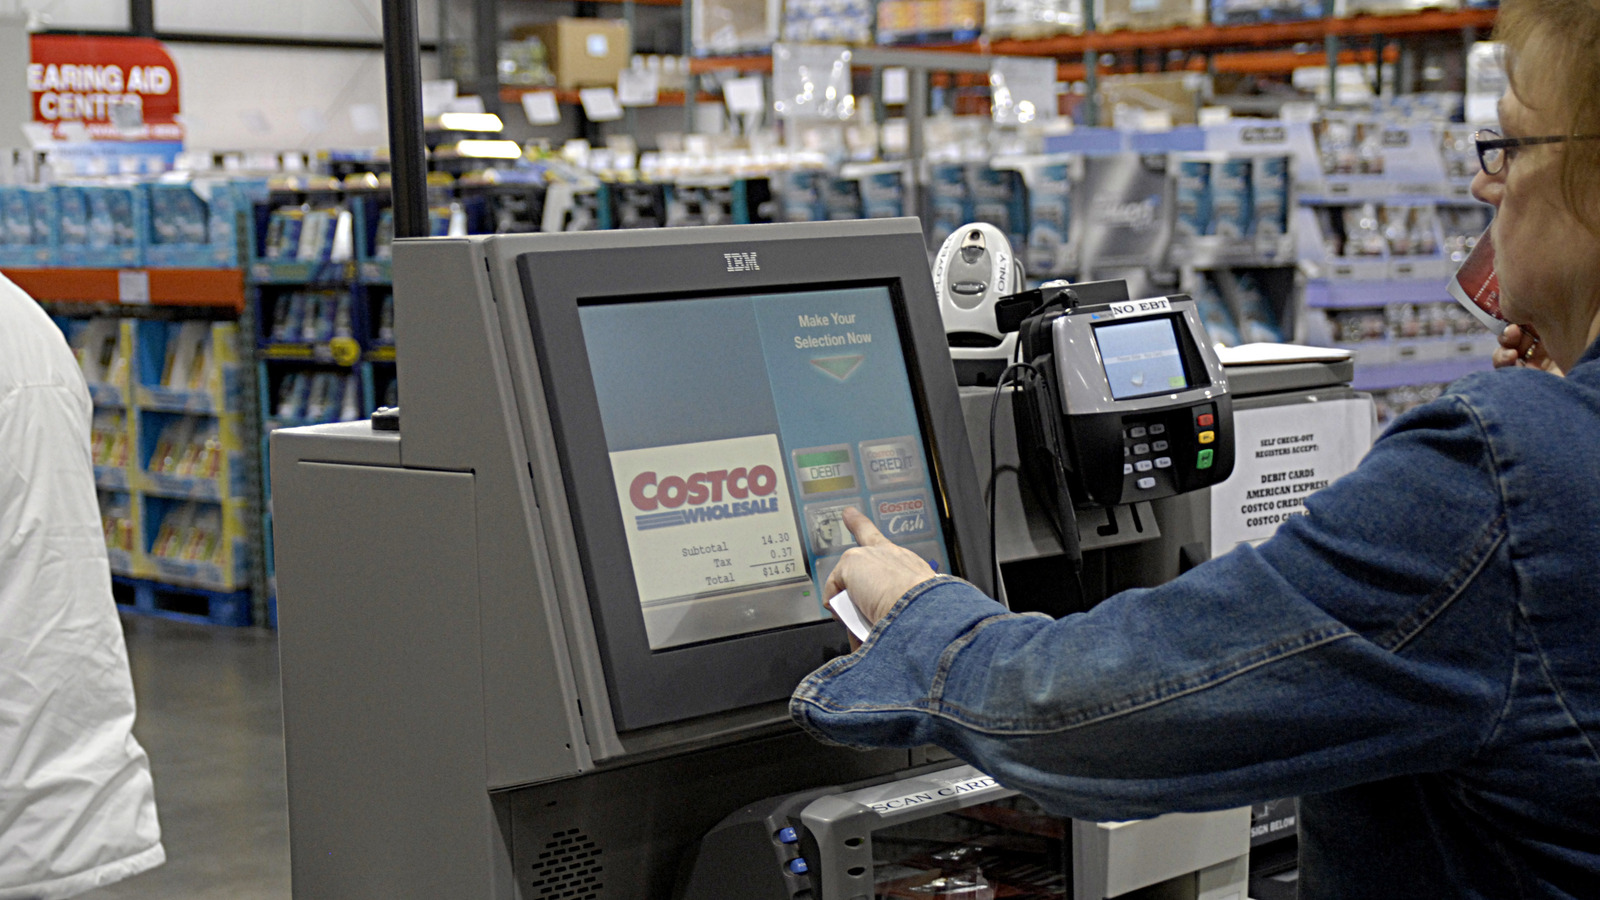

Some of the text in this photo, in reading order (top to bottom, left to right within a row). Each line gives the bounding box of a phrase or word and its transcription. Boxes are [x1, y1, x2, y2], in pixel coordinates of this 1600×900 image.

[127, 65, 172, 95] AID
[724, 252, 760, 272] IBM
[998, 253, 1007, 292] ONLY
[1112, 304, 1134, 315] NO
[1139, 300, 1168, 311] EBT
[798, 312, 856, 327] Make Your
[793, 331, 872, 349] Selection Now
[1260, 433, 1314, 447] SELF CHECK-OUT
[1255, 447, 1291, 459] REGISTERS
[810, 464, 840, 479] DEBIT
[870, 455, 913, 473] CREDIT
[1261, 468, 1315, 484] DEBIT CARDS
[629, 464, 777, 511] COSTCO
[1246, 480, 1329, 500] AMERICAN EXPRESS
[682, 497, 779, 524] WHOLESALE
[880, 499, 923, 513] COSTCO
[1241, 501, 1275, 514] COSTCO
[888, 513, 924, 534] Cash
[1246, 514, 1280, 527] COSTCO
[681, 532, 790, 557] Subtotal 14.30
[713, 547, 793, 568] Tax 0.37
[705, 562, 796, 586] Total $14.67
[872, 779, 995, 811] SCAN CARD
[1250, 816, 1295, 838] SIGN BELOW
